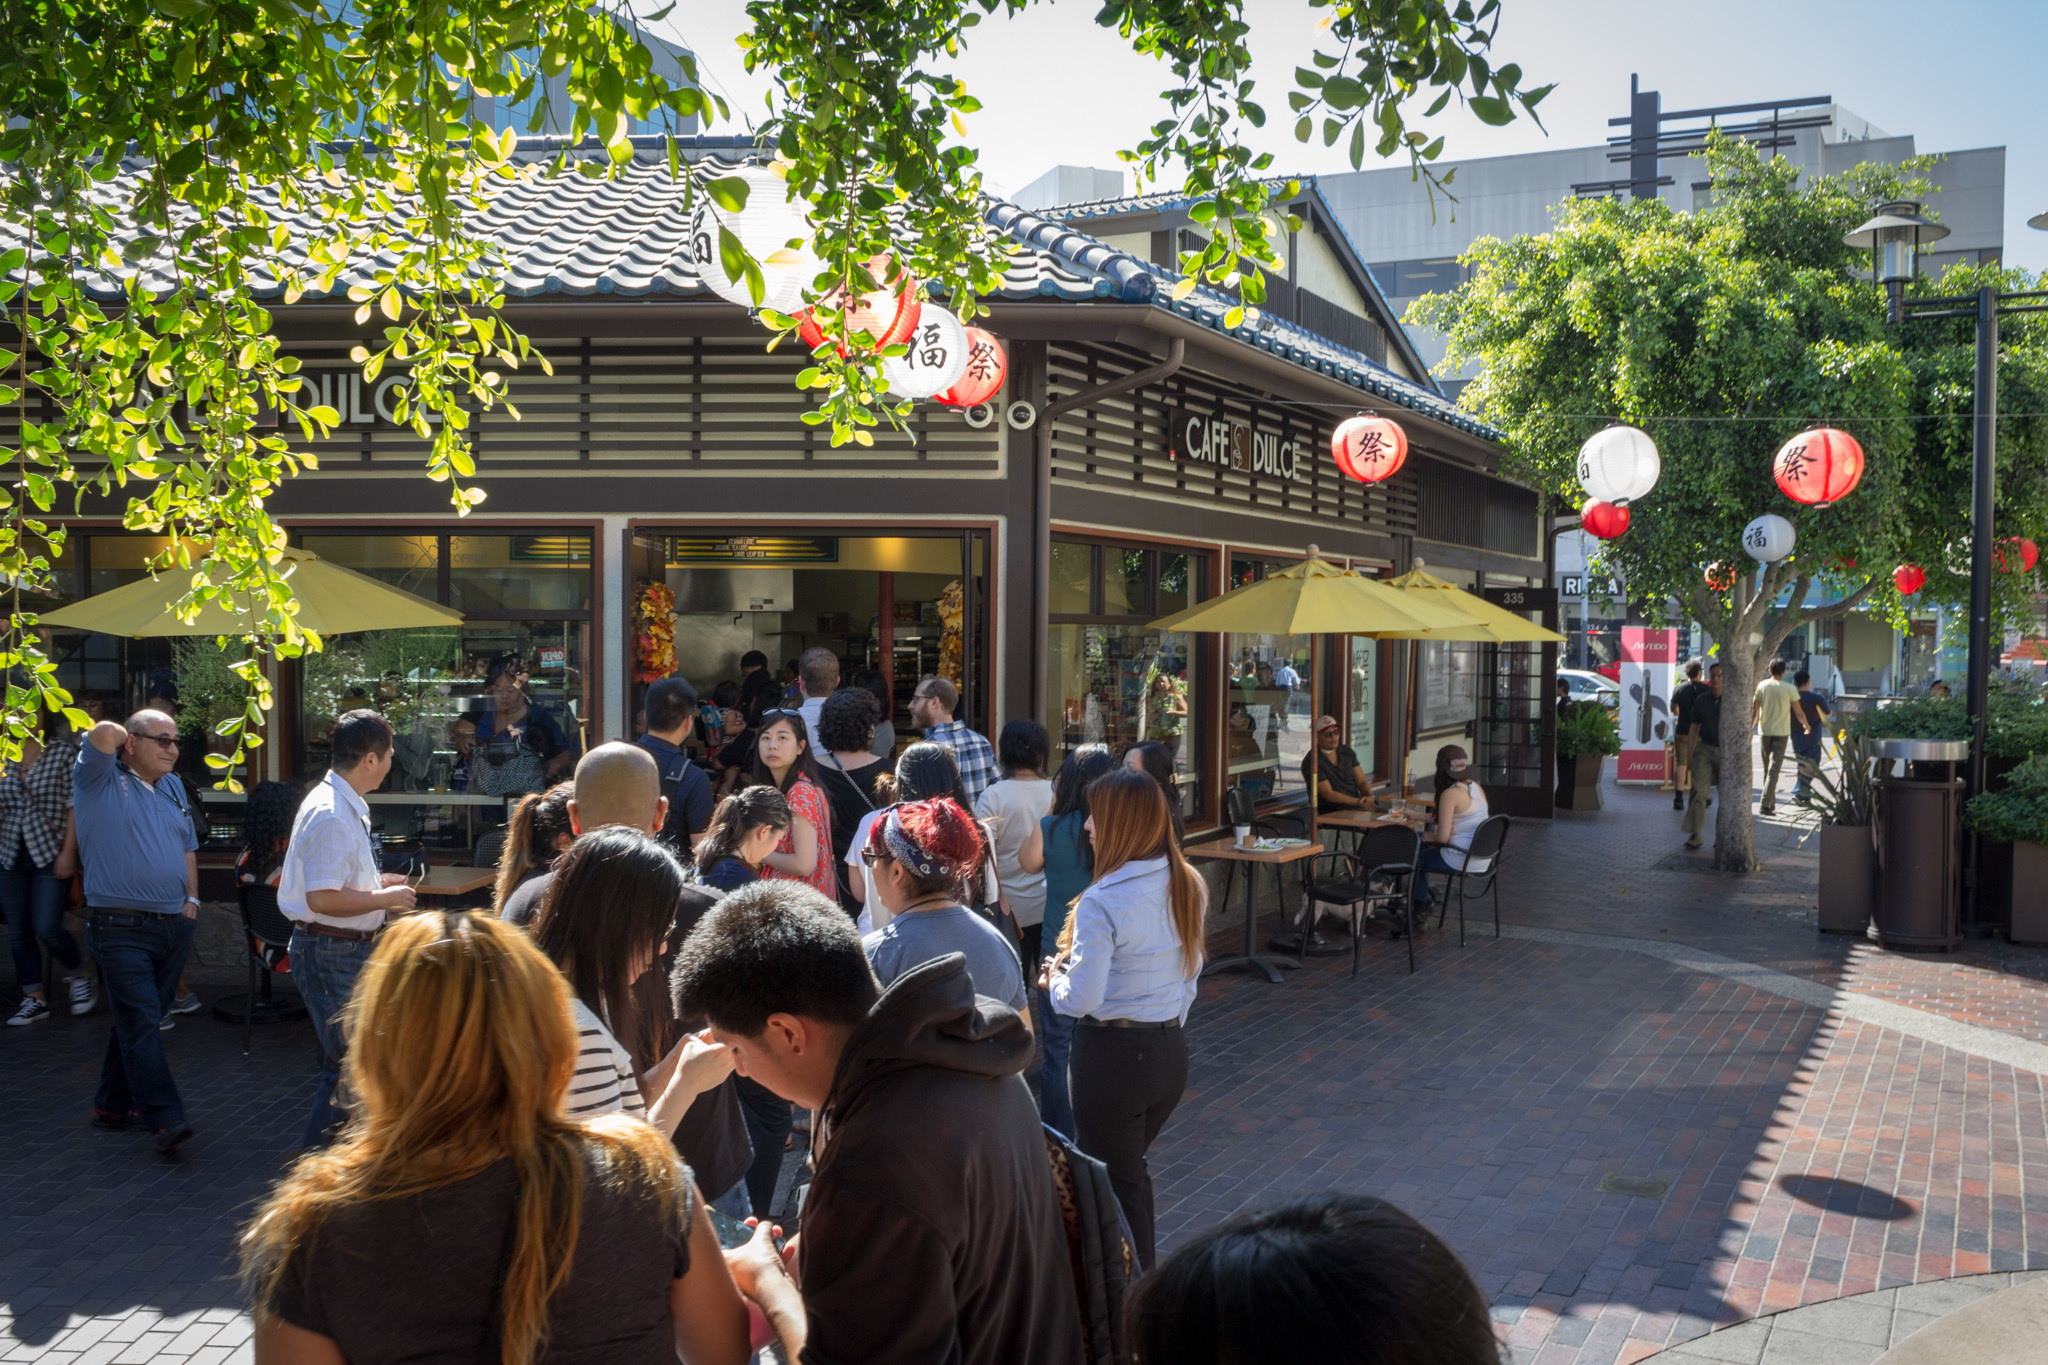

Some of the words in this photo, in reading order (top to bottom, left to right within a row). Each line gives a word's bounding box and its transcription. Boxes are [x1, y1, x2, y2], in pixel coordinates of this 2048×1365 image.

[903, 323, 947, 370] 福
[967, 341, 1001, 381] 祭
[1186, 411, 1230, 465] CAFÉ
[1355, 431, 1393, 463] 祭
[1781, 445, 1817, 481] 祭
[1746, 526, 1767, 548] 福
[1503, 592, 1524, 605] 335
[1630, 642, 1668, 650] SHISEIDO
[1626, 761, 1663, 771] SHISEIDO
